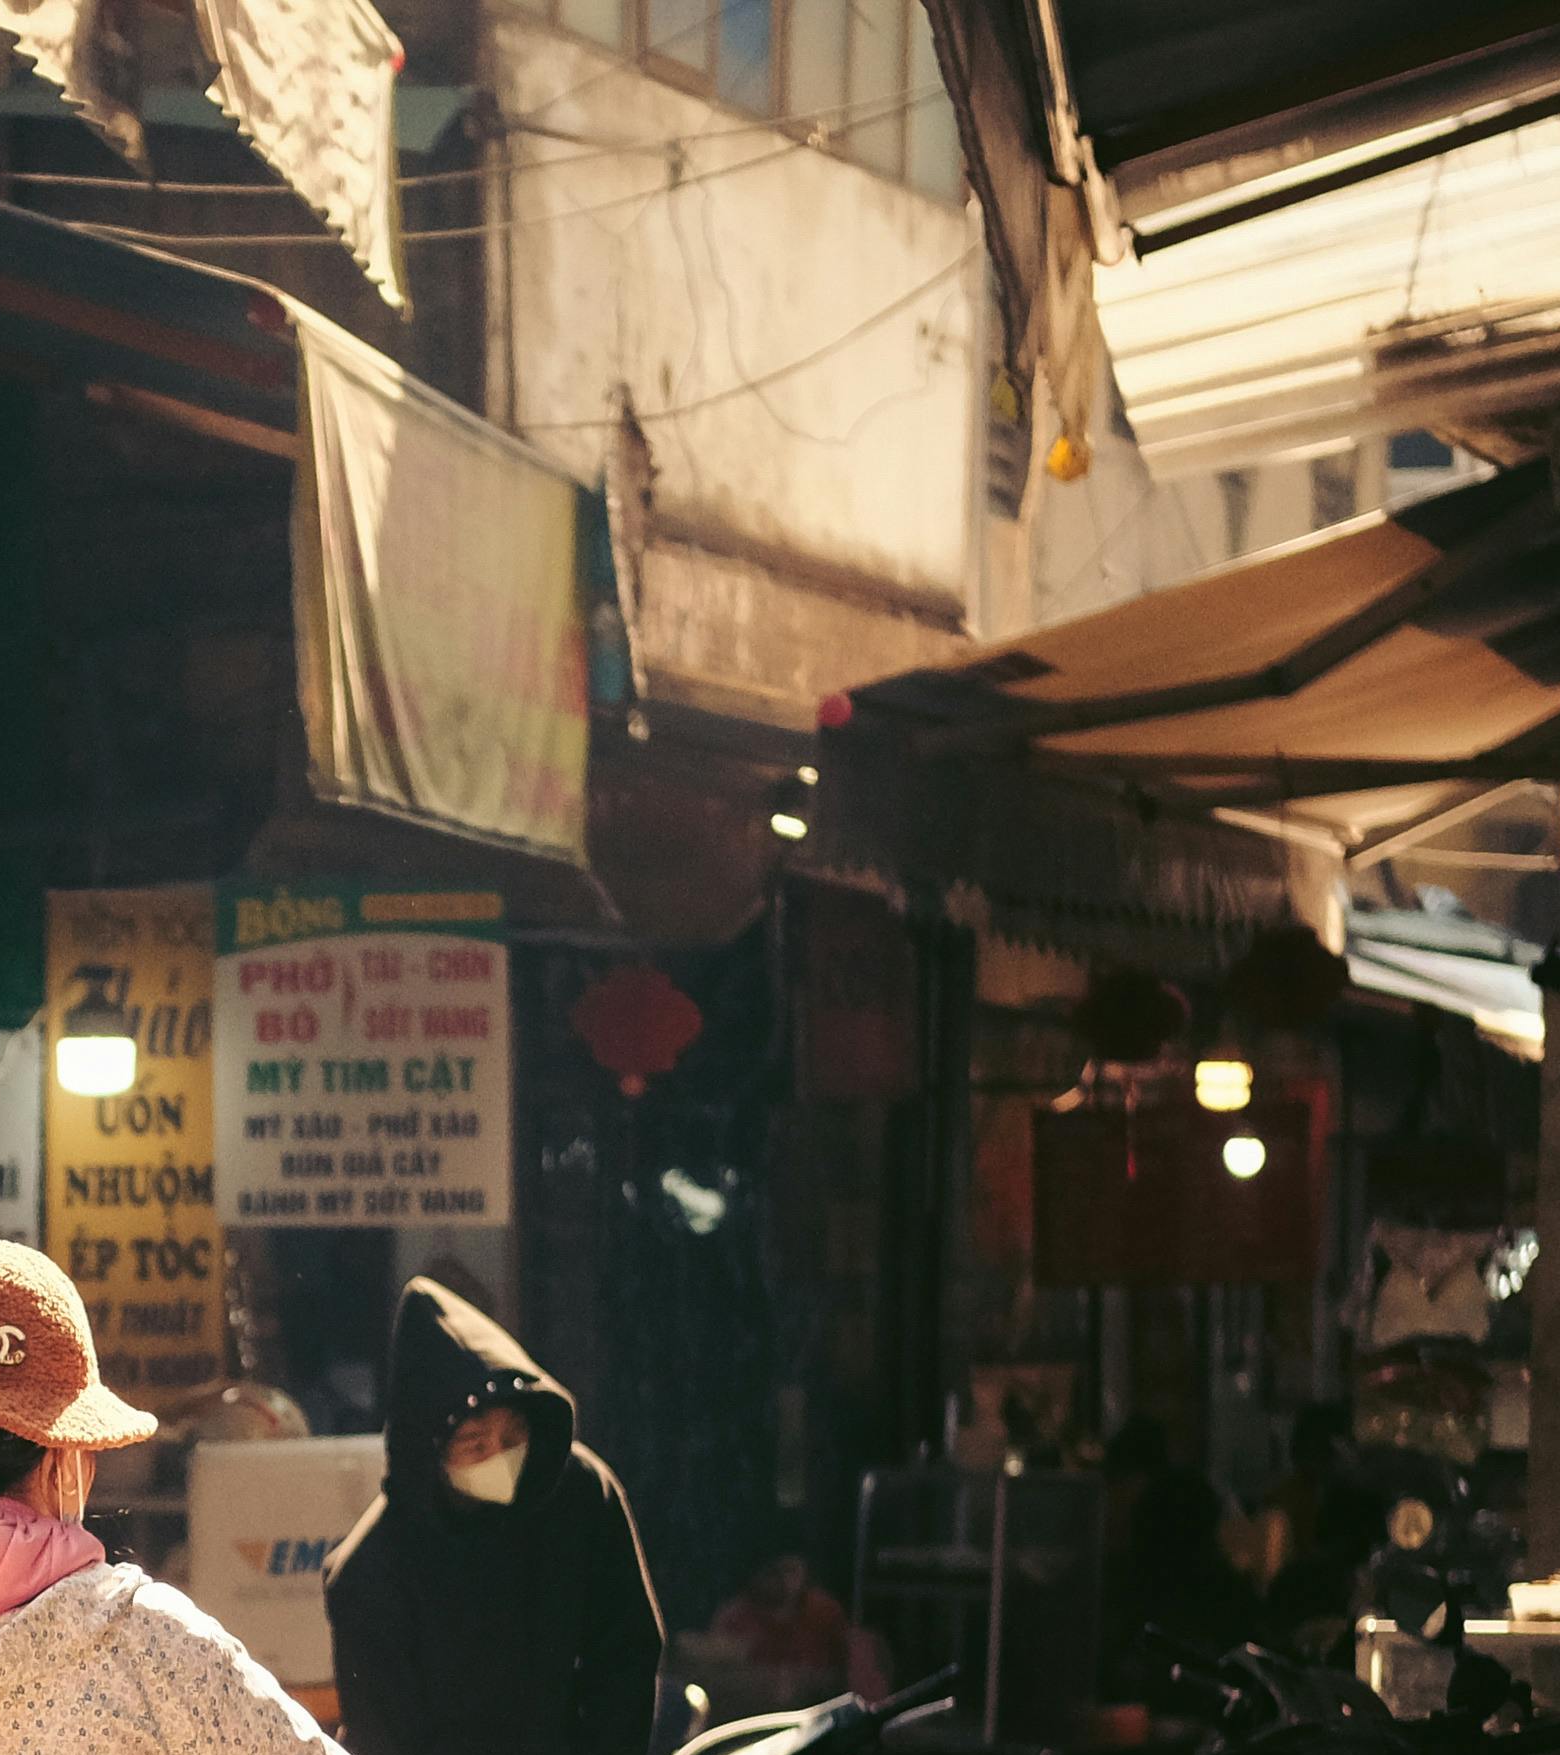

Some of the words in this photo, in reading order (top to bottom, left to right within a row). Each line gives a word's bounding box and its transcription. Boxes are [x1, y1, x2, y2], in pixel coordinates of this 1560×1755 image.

[240, 949, 335, 992] PHỞ
[320, 1059, 388, 1092] TIM
[65, 1150, 215, 1217] NHUỘM
[267, 1536, 344, 1577] EM
